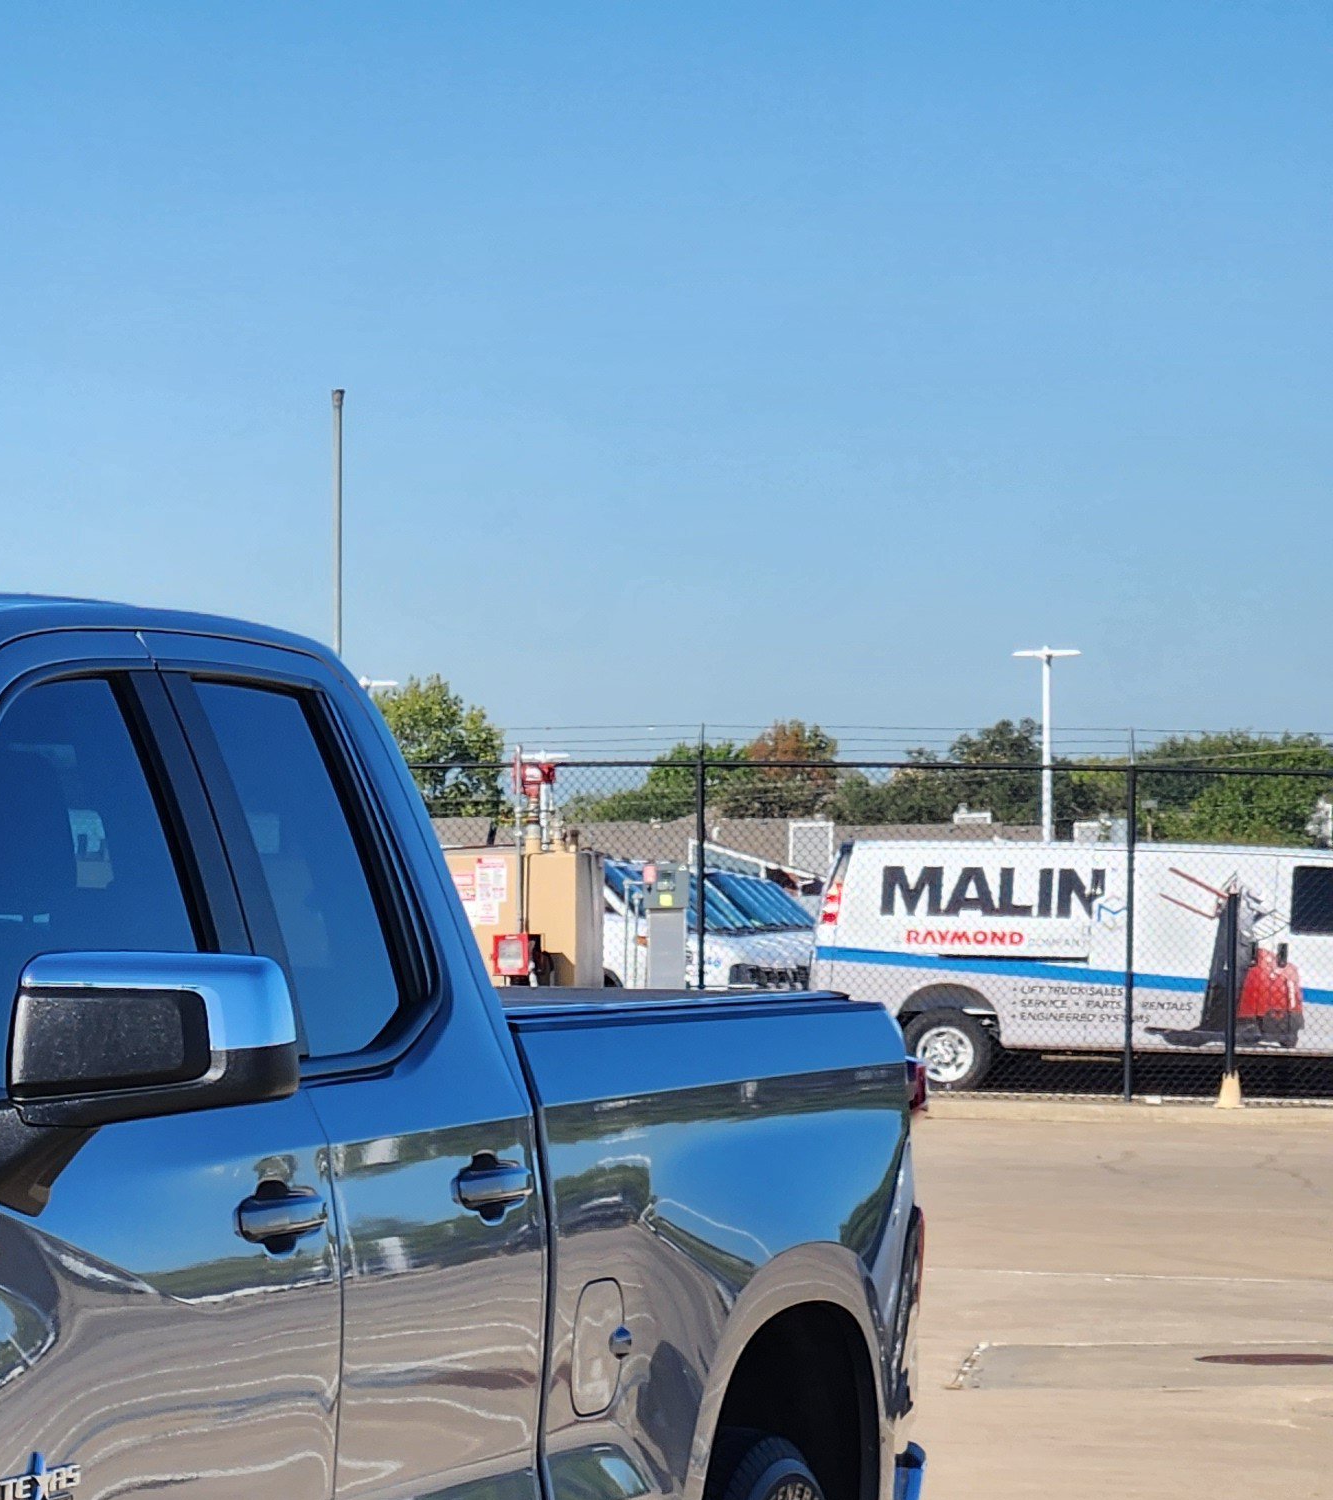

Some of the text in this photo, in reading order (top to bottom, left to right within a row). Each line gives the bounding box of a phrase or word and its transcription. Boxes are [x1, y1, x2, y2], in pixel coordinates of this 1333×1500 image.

[880, 865, 1106, 919] MALIN
[906, 929, 1024, 946] RAYMOND
[1021, 986, 1124, 997] LIFT TRUCK SALES
[1021, 999, 1193, 1011] SERVICE PARTS RENTALS
[1020, 1012, 1096, 1022] ENGINEERED
